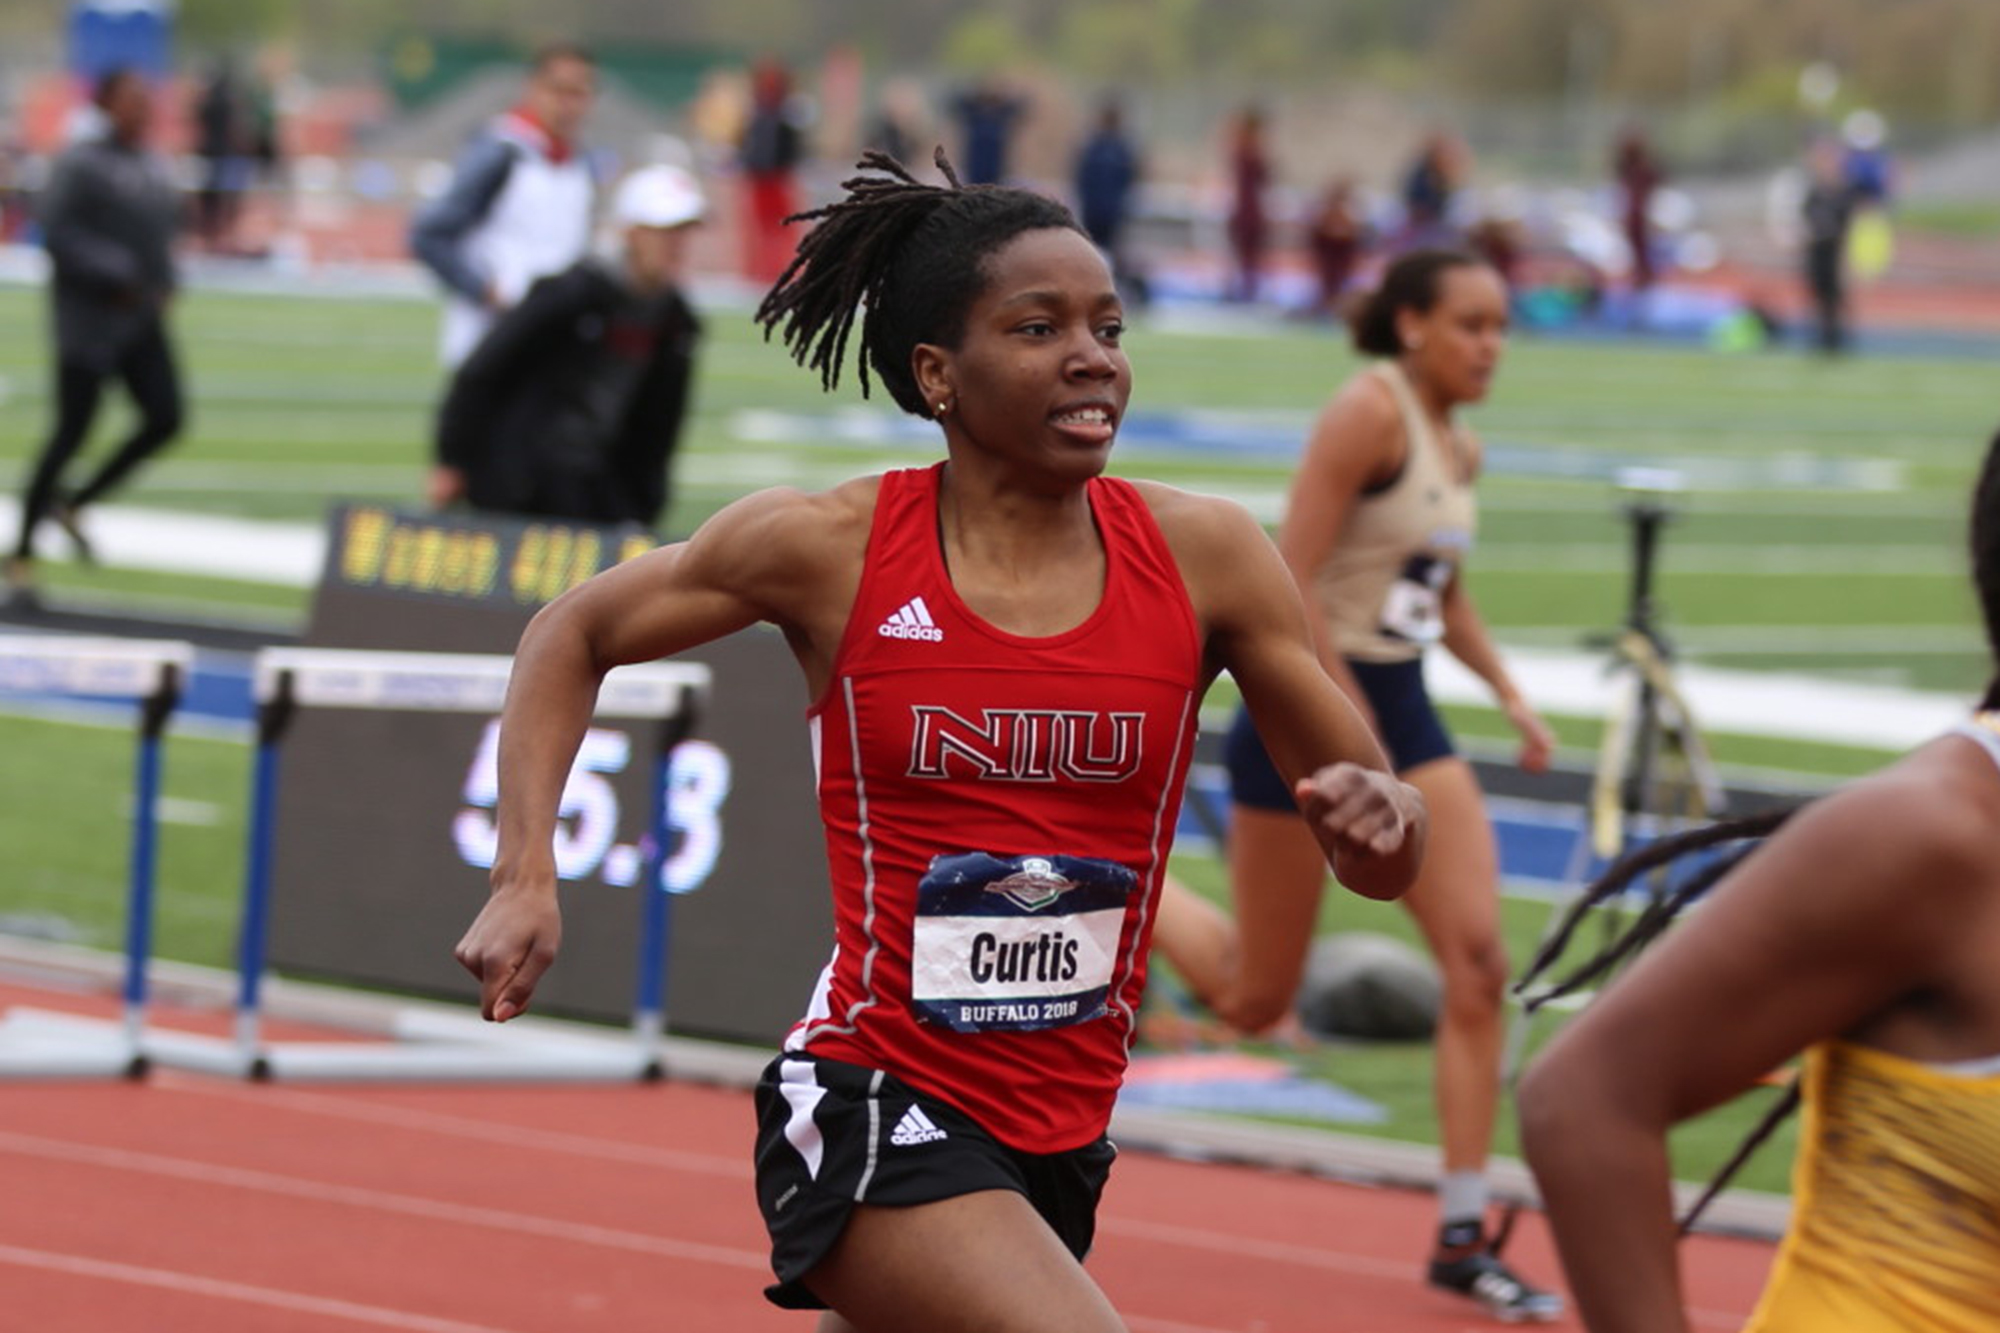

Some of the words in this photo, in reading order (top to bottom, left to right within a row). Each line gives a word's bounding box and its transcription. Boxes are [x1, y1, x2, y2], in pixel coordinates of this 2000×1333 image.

[878, 622, 943, 642] adidas
[906, 705, 1146, 783] NIU
[970, 931, 1078, 984] Curtis
[960, 1004, 1039, 1023] BUFFALO
[1043, 1001, 1078, 1020] 2018
[890, 1129, 948, 1147] adidas
